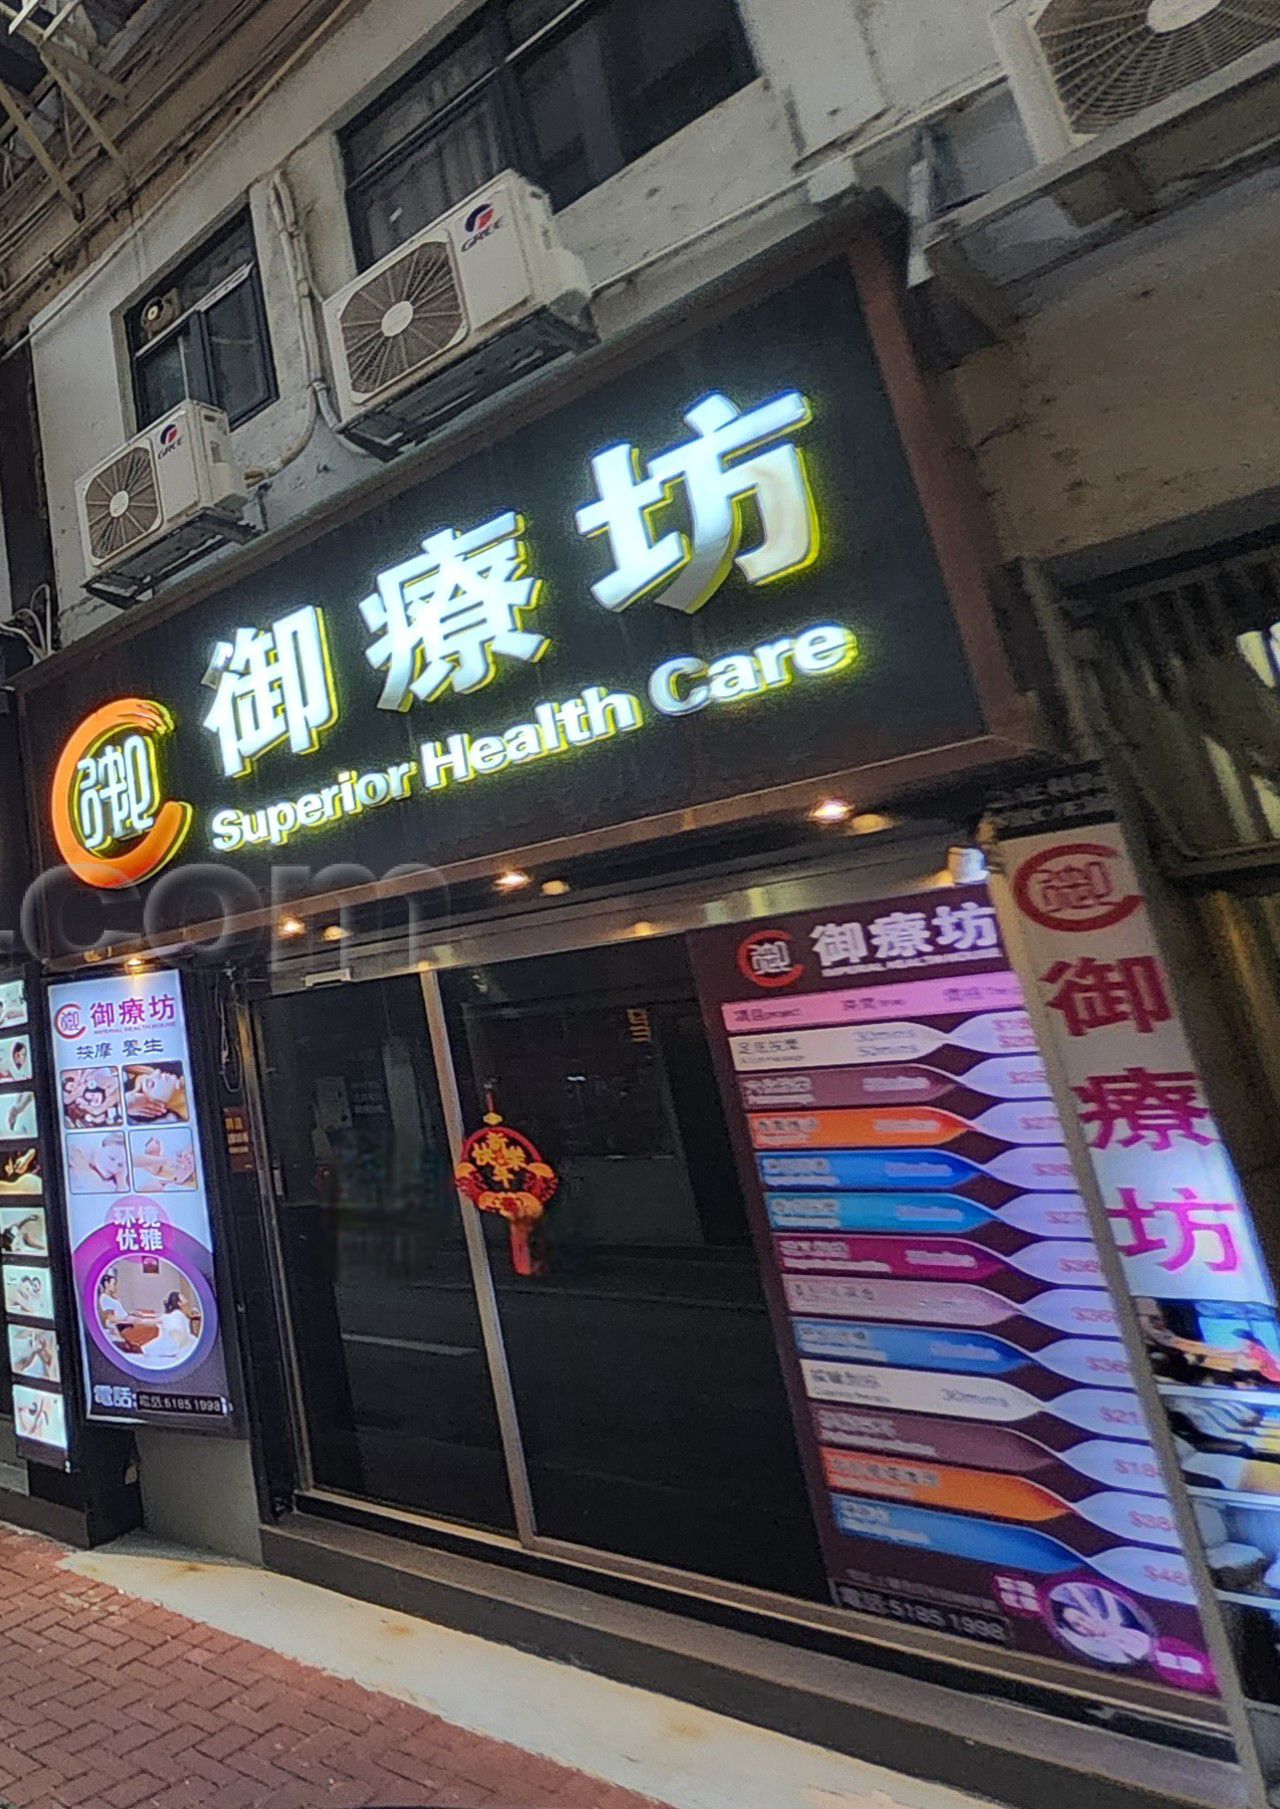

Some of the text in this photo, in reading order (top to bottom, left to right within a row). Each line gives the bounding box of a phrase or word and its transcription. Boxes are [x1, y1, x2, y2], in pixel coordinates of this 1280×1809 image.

[201, 389, 822, 778] 御療坊
[211, 621, 858, 851] Superior Health Care
[810, 902, 999, 966] 御療坊
[90, 993, 176, 1028] 御療坊
[1040, 955, 1239, 1272] 御療坊
[113, 1205, 162, 1228] 环境
[115, 1227, 164, 1251] 优雅
